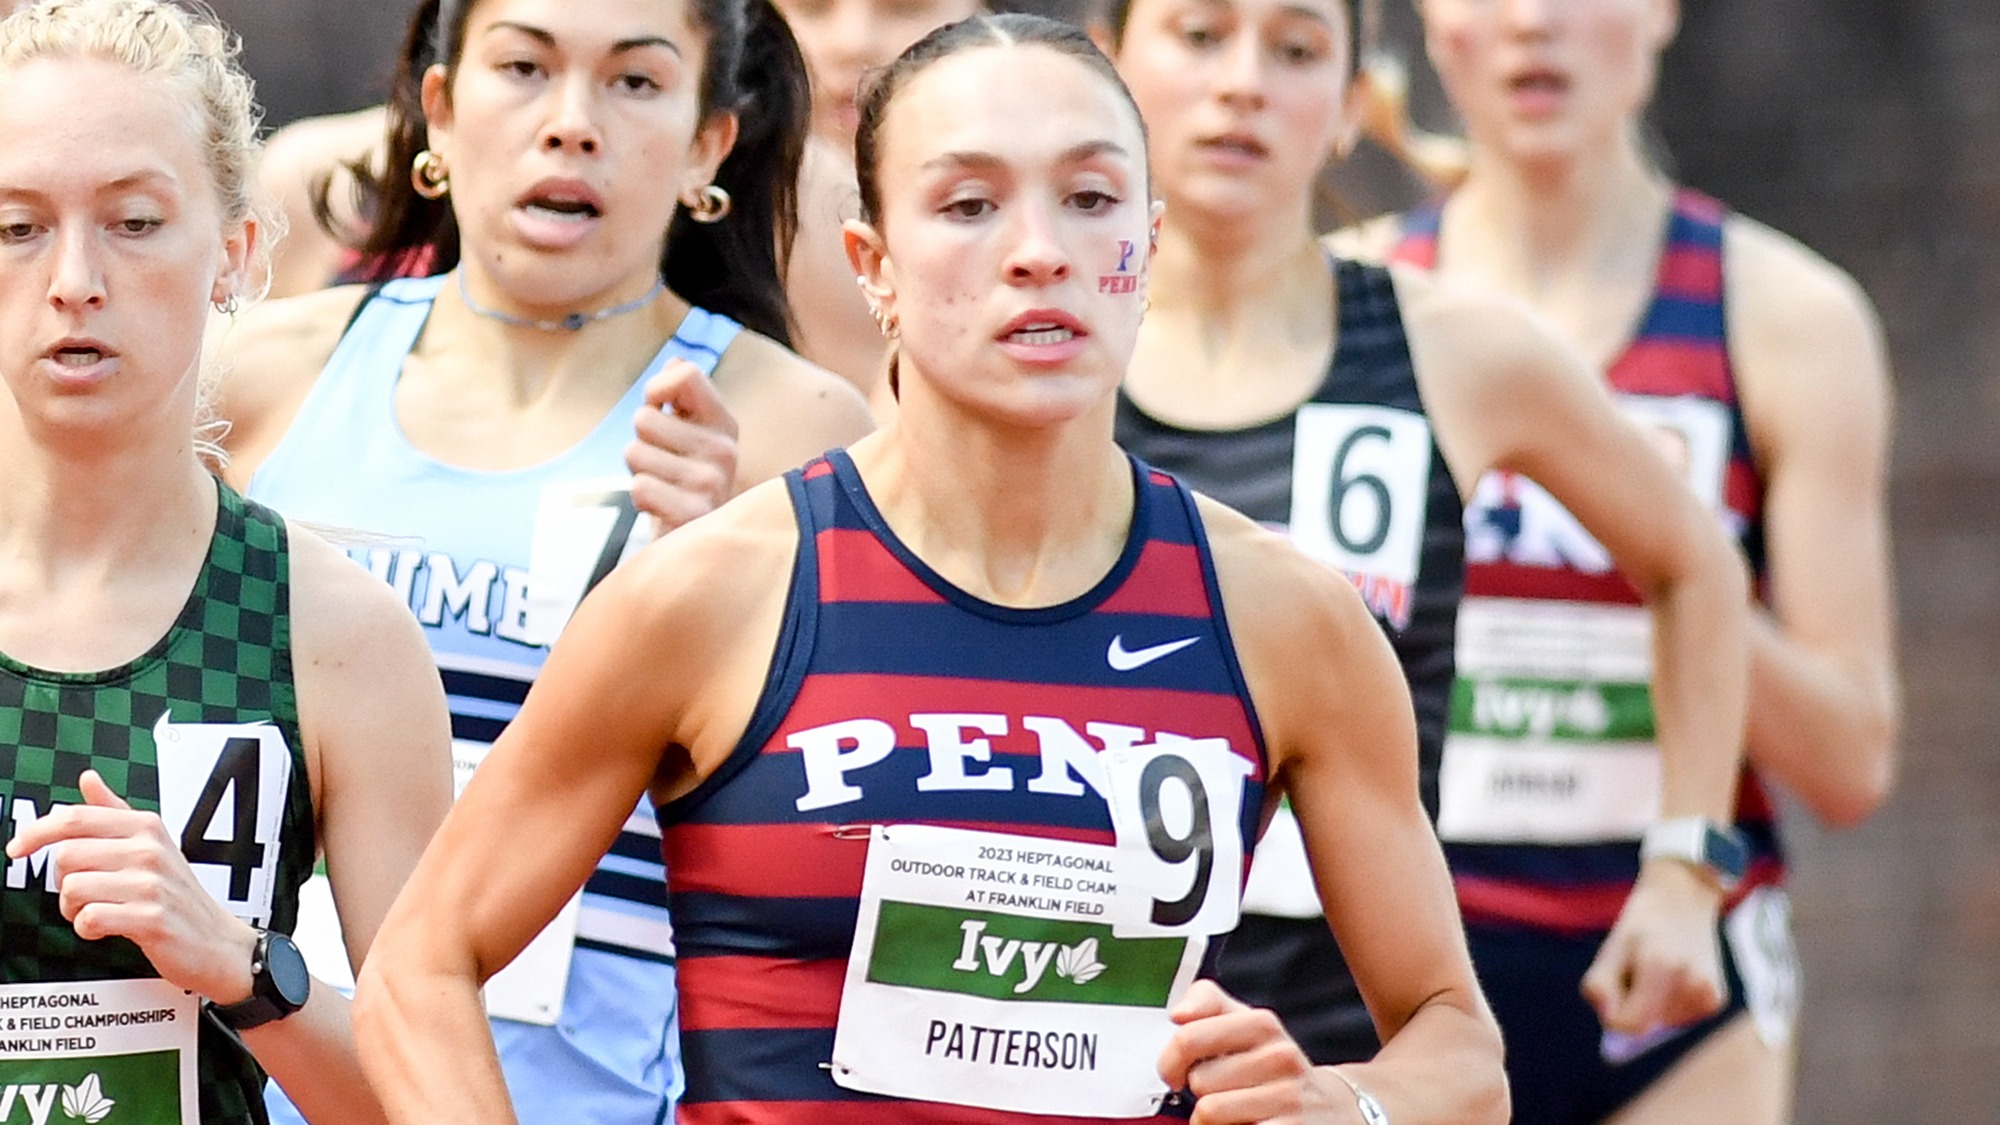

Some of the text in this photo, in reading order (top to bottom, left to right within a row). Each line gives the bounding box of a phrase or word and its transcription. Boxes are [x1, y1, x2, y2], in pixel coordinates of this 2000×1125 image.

[1327, 425, 1392, 554] 6
[367, 549, 548, 649] UMB
[180, 737, 267, 903] 4
[1139, 753, 1214, 927] 9
[890, 858, 965, 880] OUTDOOR
[969, 867, 1016, 885] TRACK
[1019, 873, 1030, 886] &
[1032, 874, 1074, 891] FIELD
[977, 846, 1115, 874] 2023 HEPTAGONAL
[964, 890, 1104, 916] AT FRANKLIN FIELD
[952, 919, 1057, 994] Ivy
[0, 993, 99, 1009] HEPTAGONAL
[6, 1018, 16, 1030] &
[20, 1016, 61, 1030] FIELD
[64, 1008, 176, 1029] CHAMPIONSHIPS
[0, 1036, 96, 1052] ANKLIN FIELD
[924, 1019, 1099, 1071] PATTERSON
[0, 1084, 58, 1125] vy
